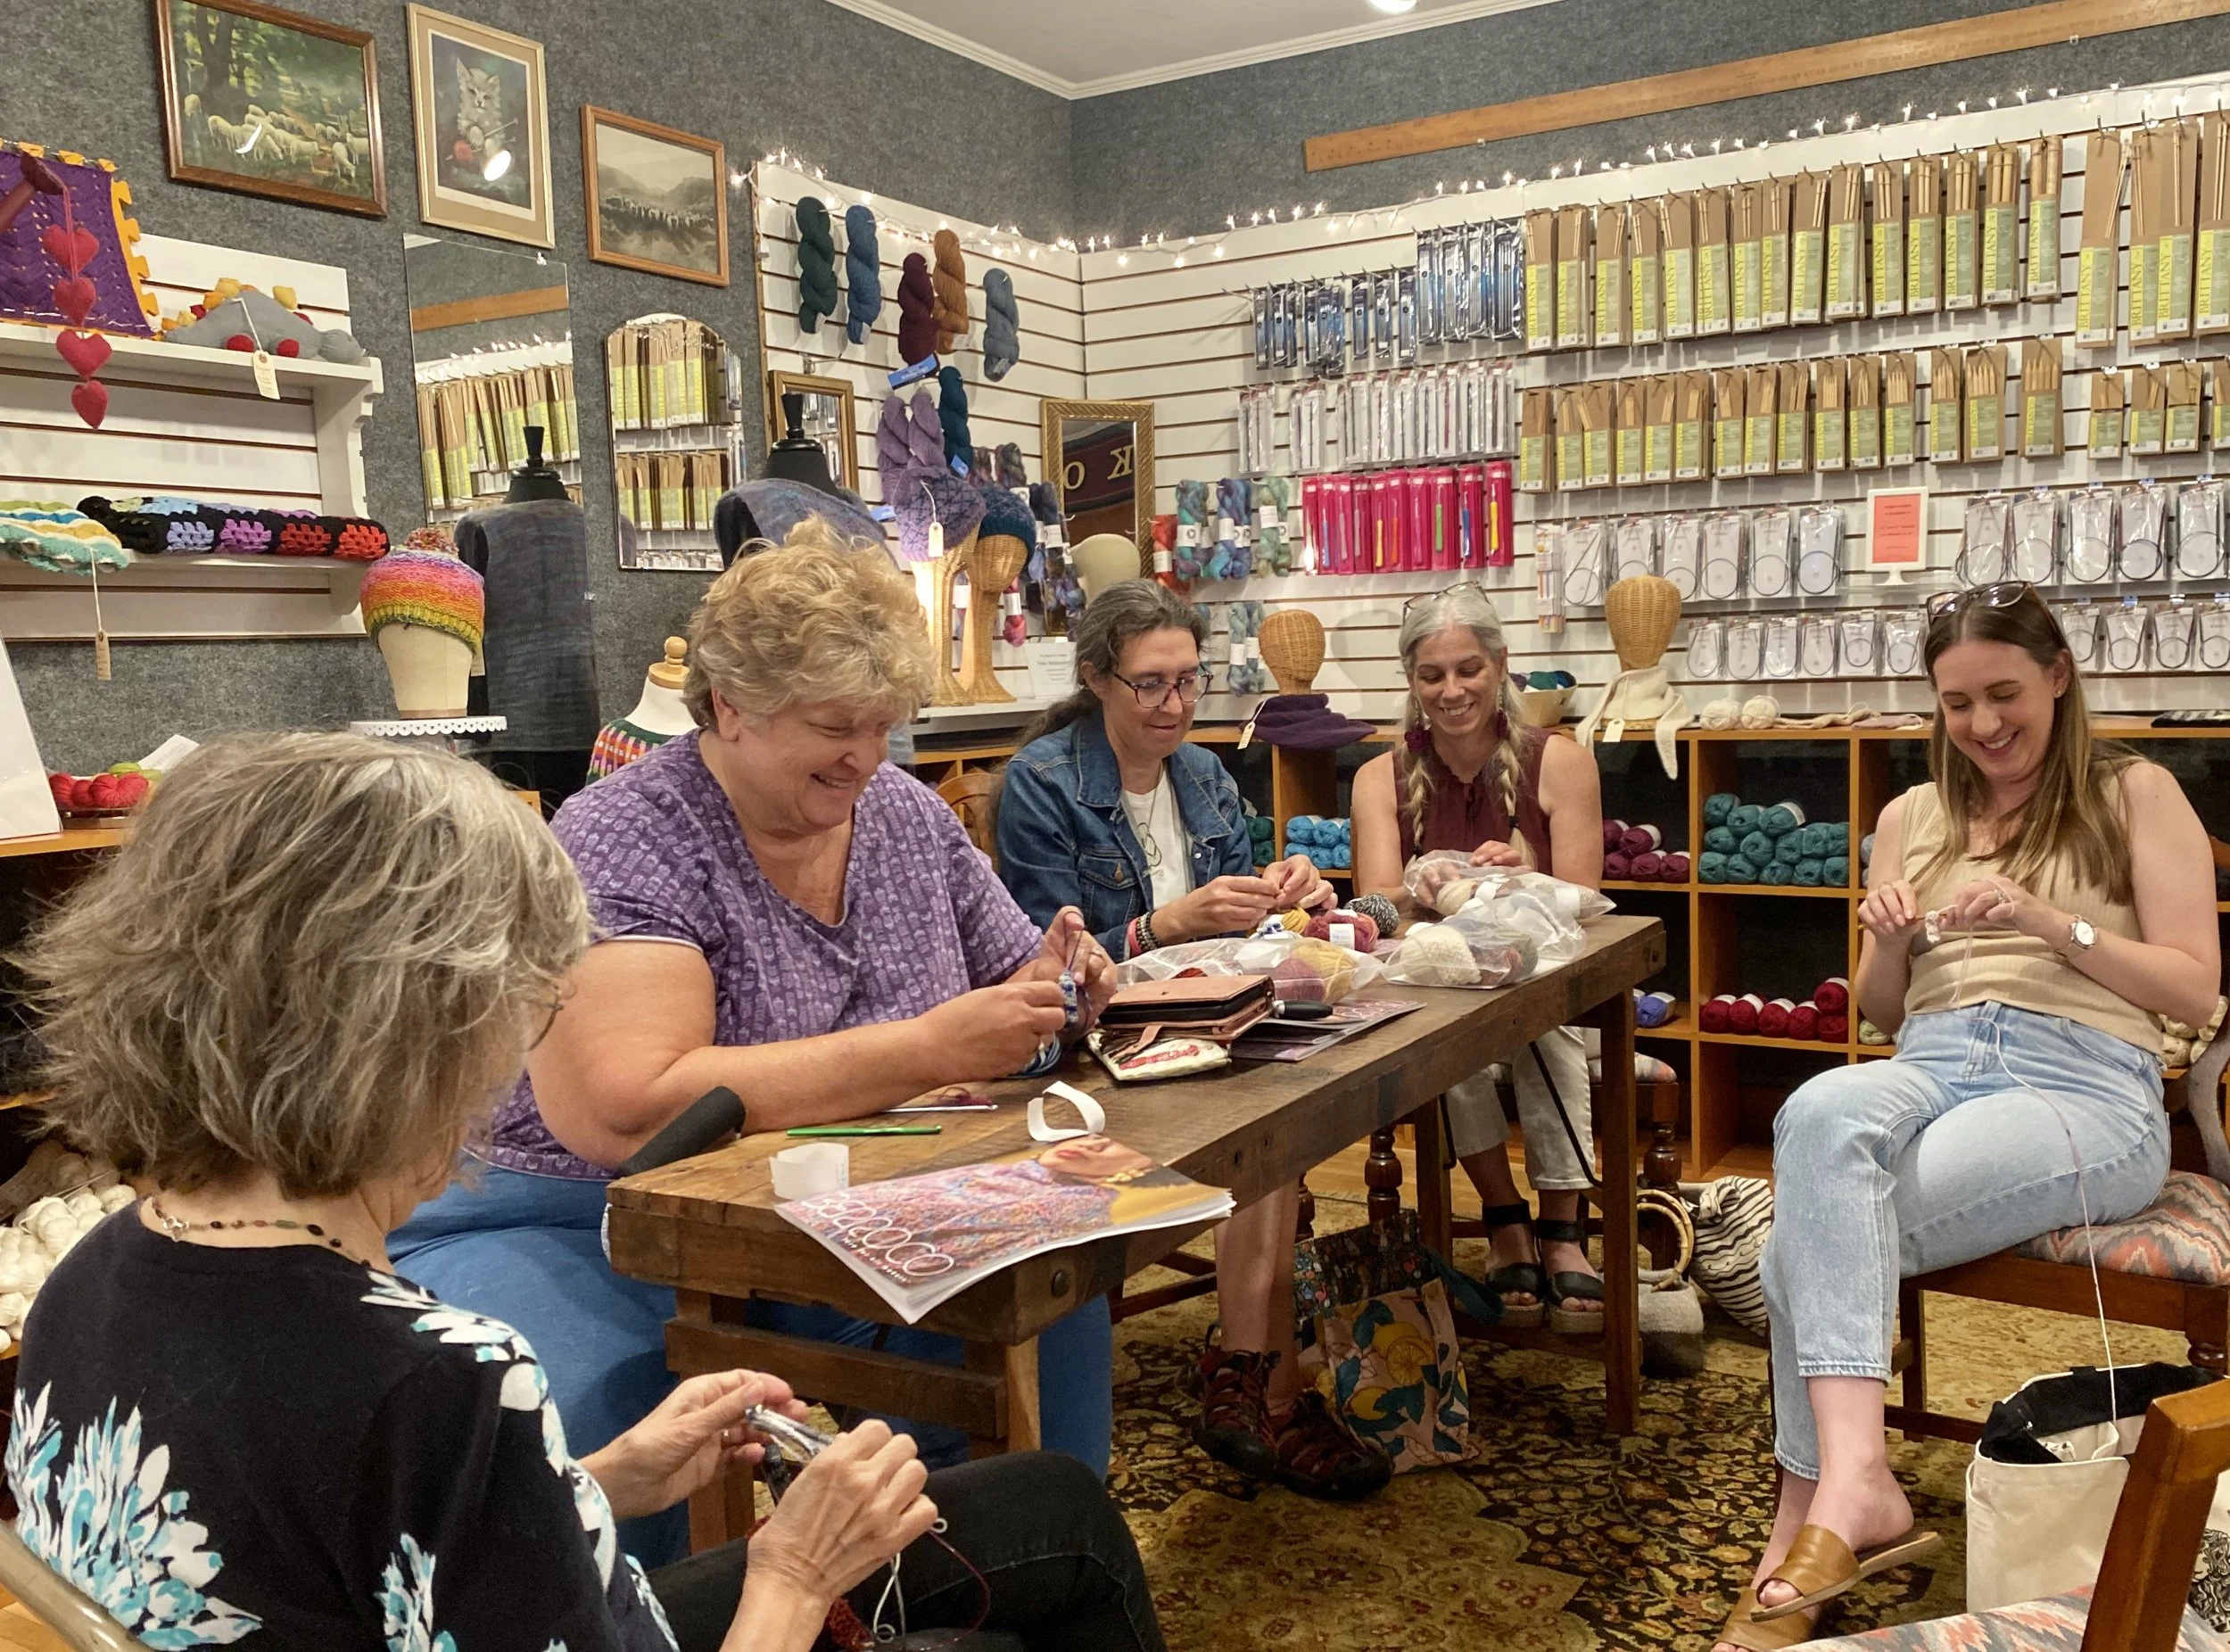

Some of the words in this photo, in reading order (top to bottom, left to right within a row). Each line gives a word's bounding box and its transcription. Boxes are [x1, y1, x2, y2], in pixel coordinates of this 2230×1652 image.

[1829, 242, 1838, 301] BRITTANY
[1875, 241, 1884, 300] BRITTANY
[1911, 237, 1919, 297] BRITTANY
[1947, 235, 1956, 294] BRITTANY
[1986, 227, 1996, 290] BRITTANY
[2030, 219, 2039, 282] BRITTANY
[1633, 275, 1641, 329] BRITTANY
[1667, 268, 1676, 323] BRITTANY
[1704, 263, 1713, 319] BRITTANY
[1736, 260, 1745, 318] BRITTANY
[1763, 254, 1772, 311] BRITTANY
[2078, 266, 2092, 328] BRITTANY
[2131, 264, 2142, 326] BRITTANY
[2159, 254, 2170, 318] BRITTANY
[2199, 249, 2211, 314] BRITTANY
